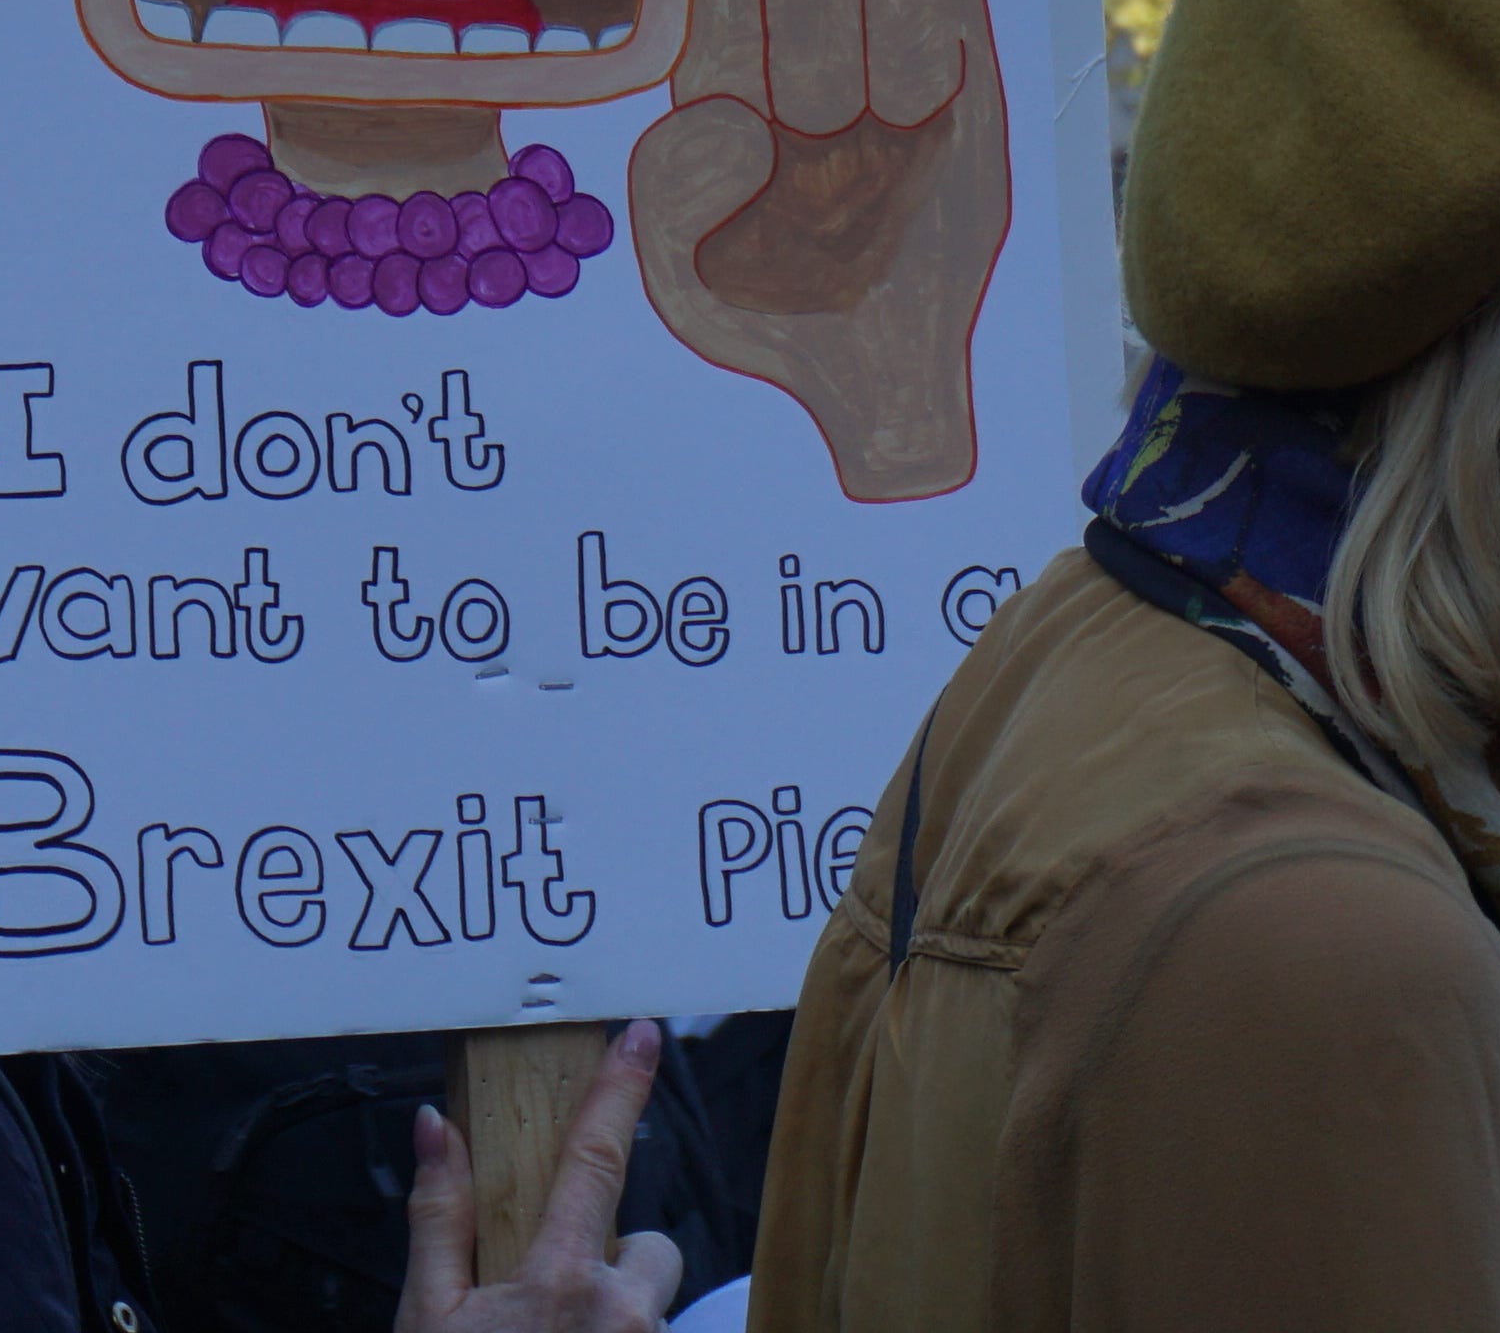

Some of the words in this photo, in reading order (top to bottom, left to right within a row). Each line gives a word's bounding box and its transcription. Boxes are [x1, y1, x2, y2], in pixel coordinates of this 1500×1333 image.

[120, 359, 506, 507] don't
[361, 546, 511, 664] to
[577, 530, 731, 668] be
[779, 553, 885, 656] in
[941, 565, 1022, 648] a
